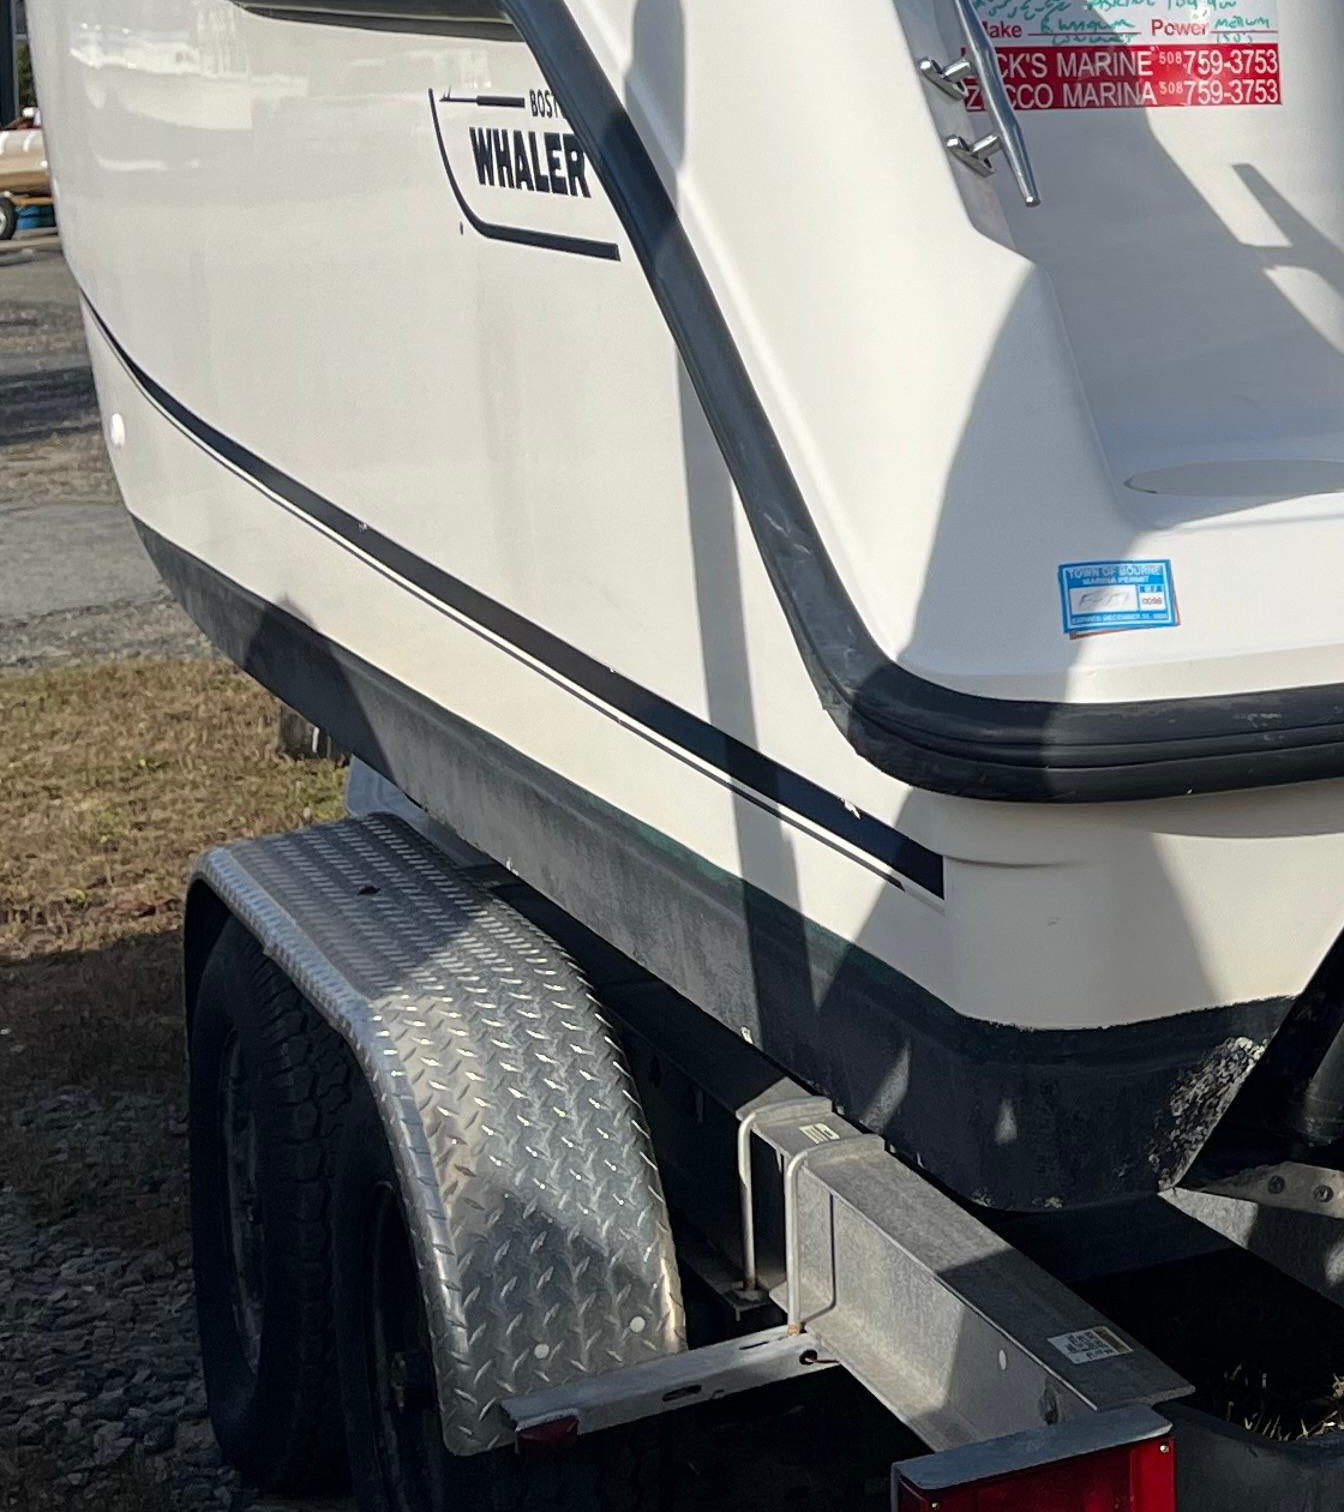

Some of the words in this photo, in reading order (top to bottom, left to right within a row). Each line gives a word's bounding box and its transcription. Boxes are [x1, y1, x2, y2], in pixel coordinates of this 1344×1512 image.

[1151, 18, 1208, 36] Power
[997, 52, 1049, 79] CK'S
[1056, 50, 1155, 78] MARINE
[1158, 51, 1183, 65] 508
[1183, 49, 1278, 75] 759-3753
[529, 88, 568, 121] BOST
[1063, 81, 1158, 107] MARINA
[1158, 81, 1184, 95] 508
[1183, 79, 1279, 105] 759-3753
[468, 126, 593, 199] WHALER
